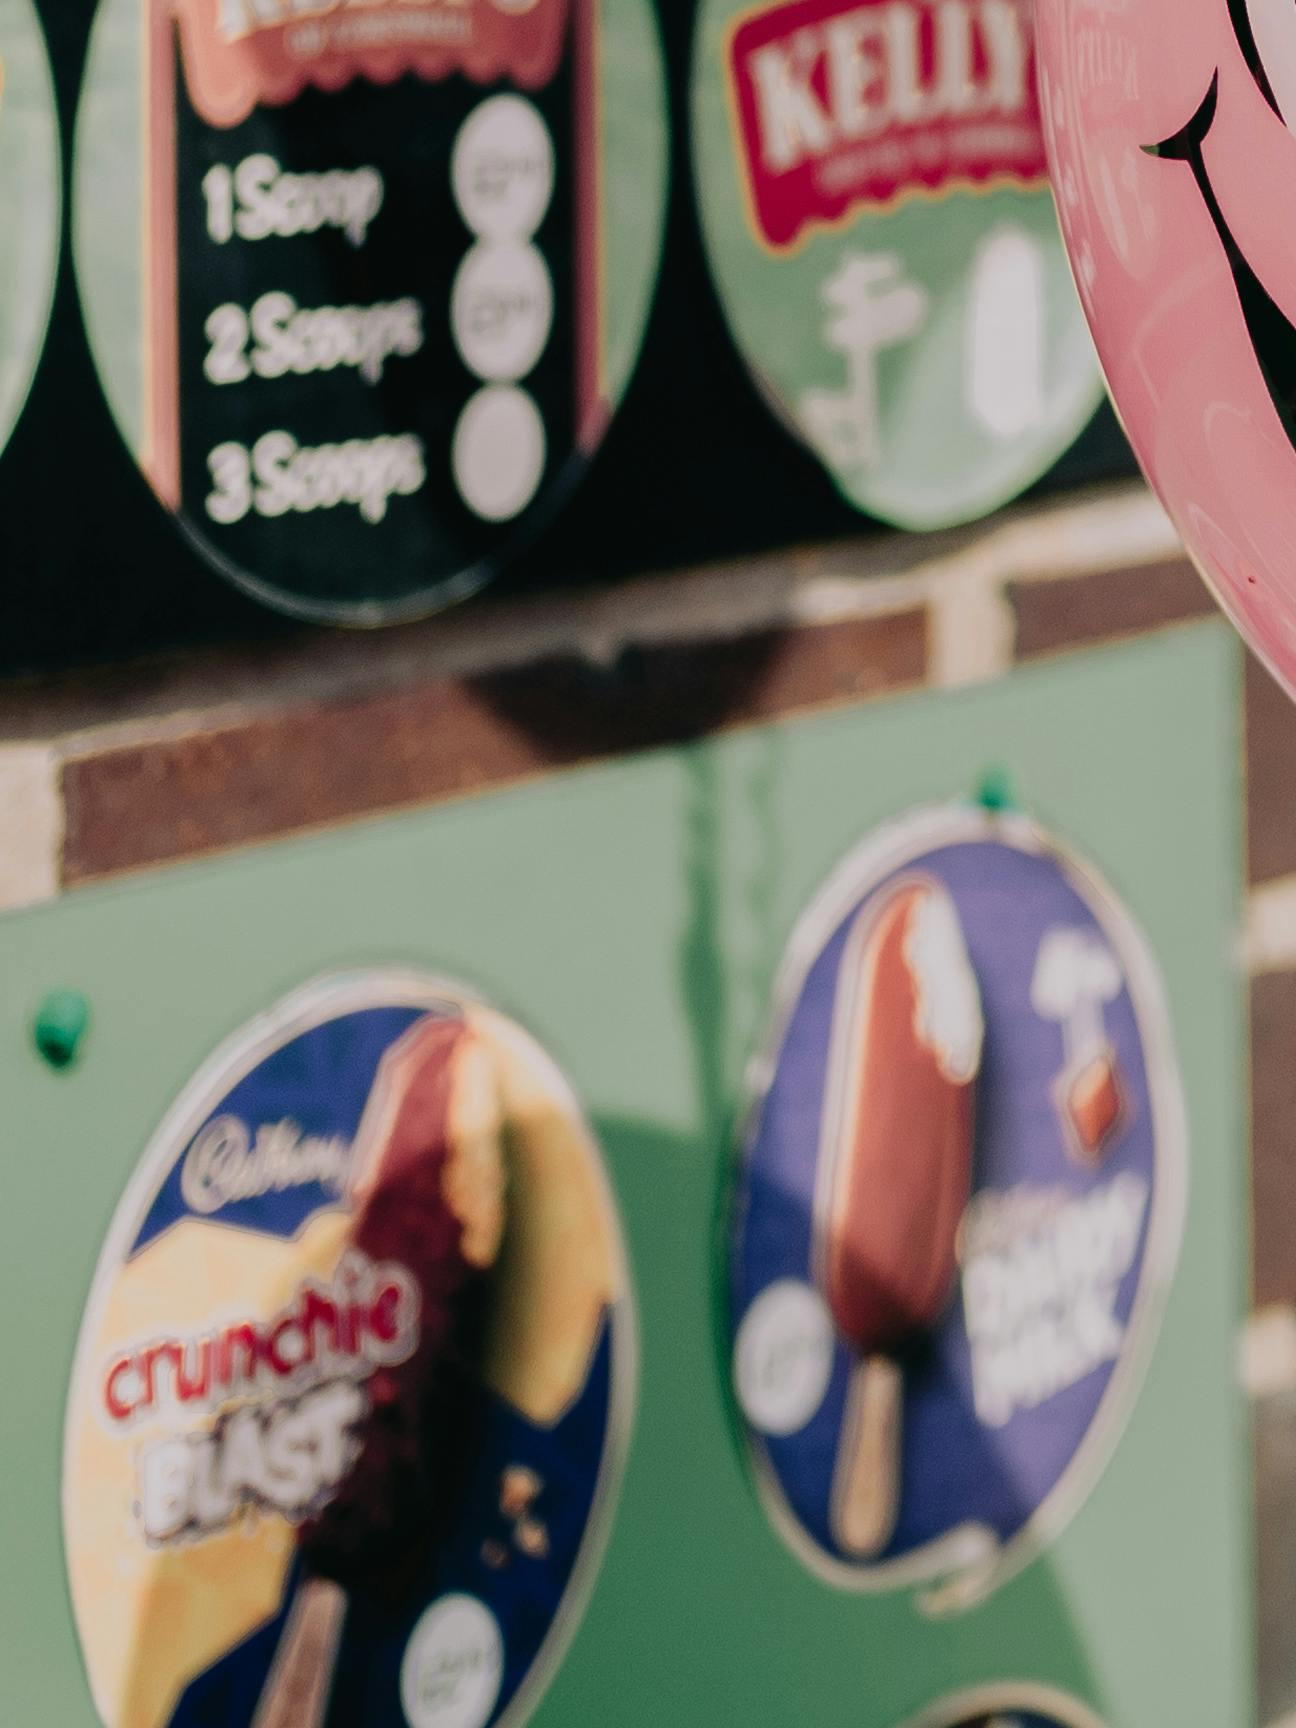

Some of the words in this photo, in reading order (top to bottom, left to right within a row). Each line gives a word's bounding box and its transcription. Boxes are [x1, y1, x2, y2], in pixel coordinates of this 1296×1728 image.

[201, 162, 233, 244] 1
[233, 152, 385, 247] Scoop
[202, 301, 252, 387] 2
[250, 290, 426, 387] Scoops
[204, 440, 252, 525] 3
[251, 429, 427, 525] Scoops
[102, 1262, 406, 1420] crunchie
[140, 1378, 370, 1544] BLAST
